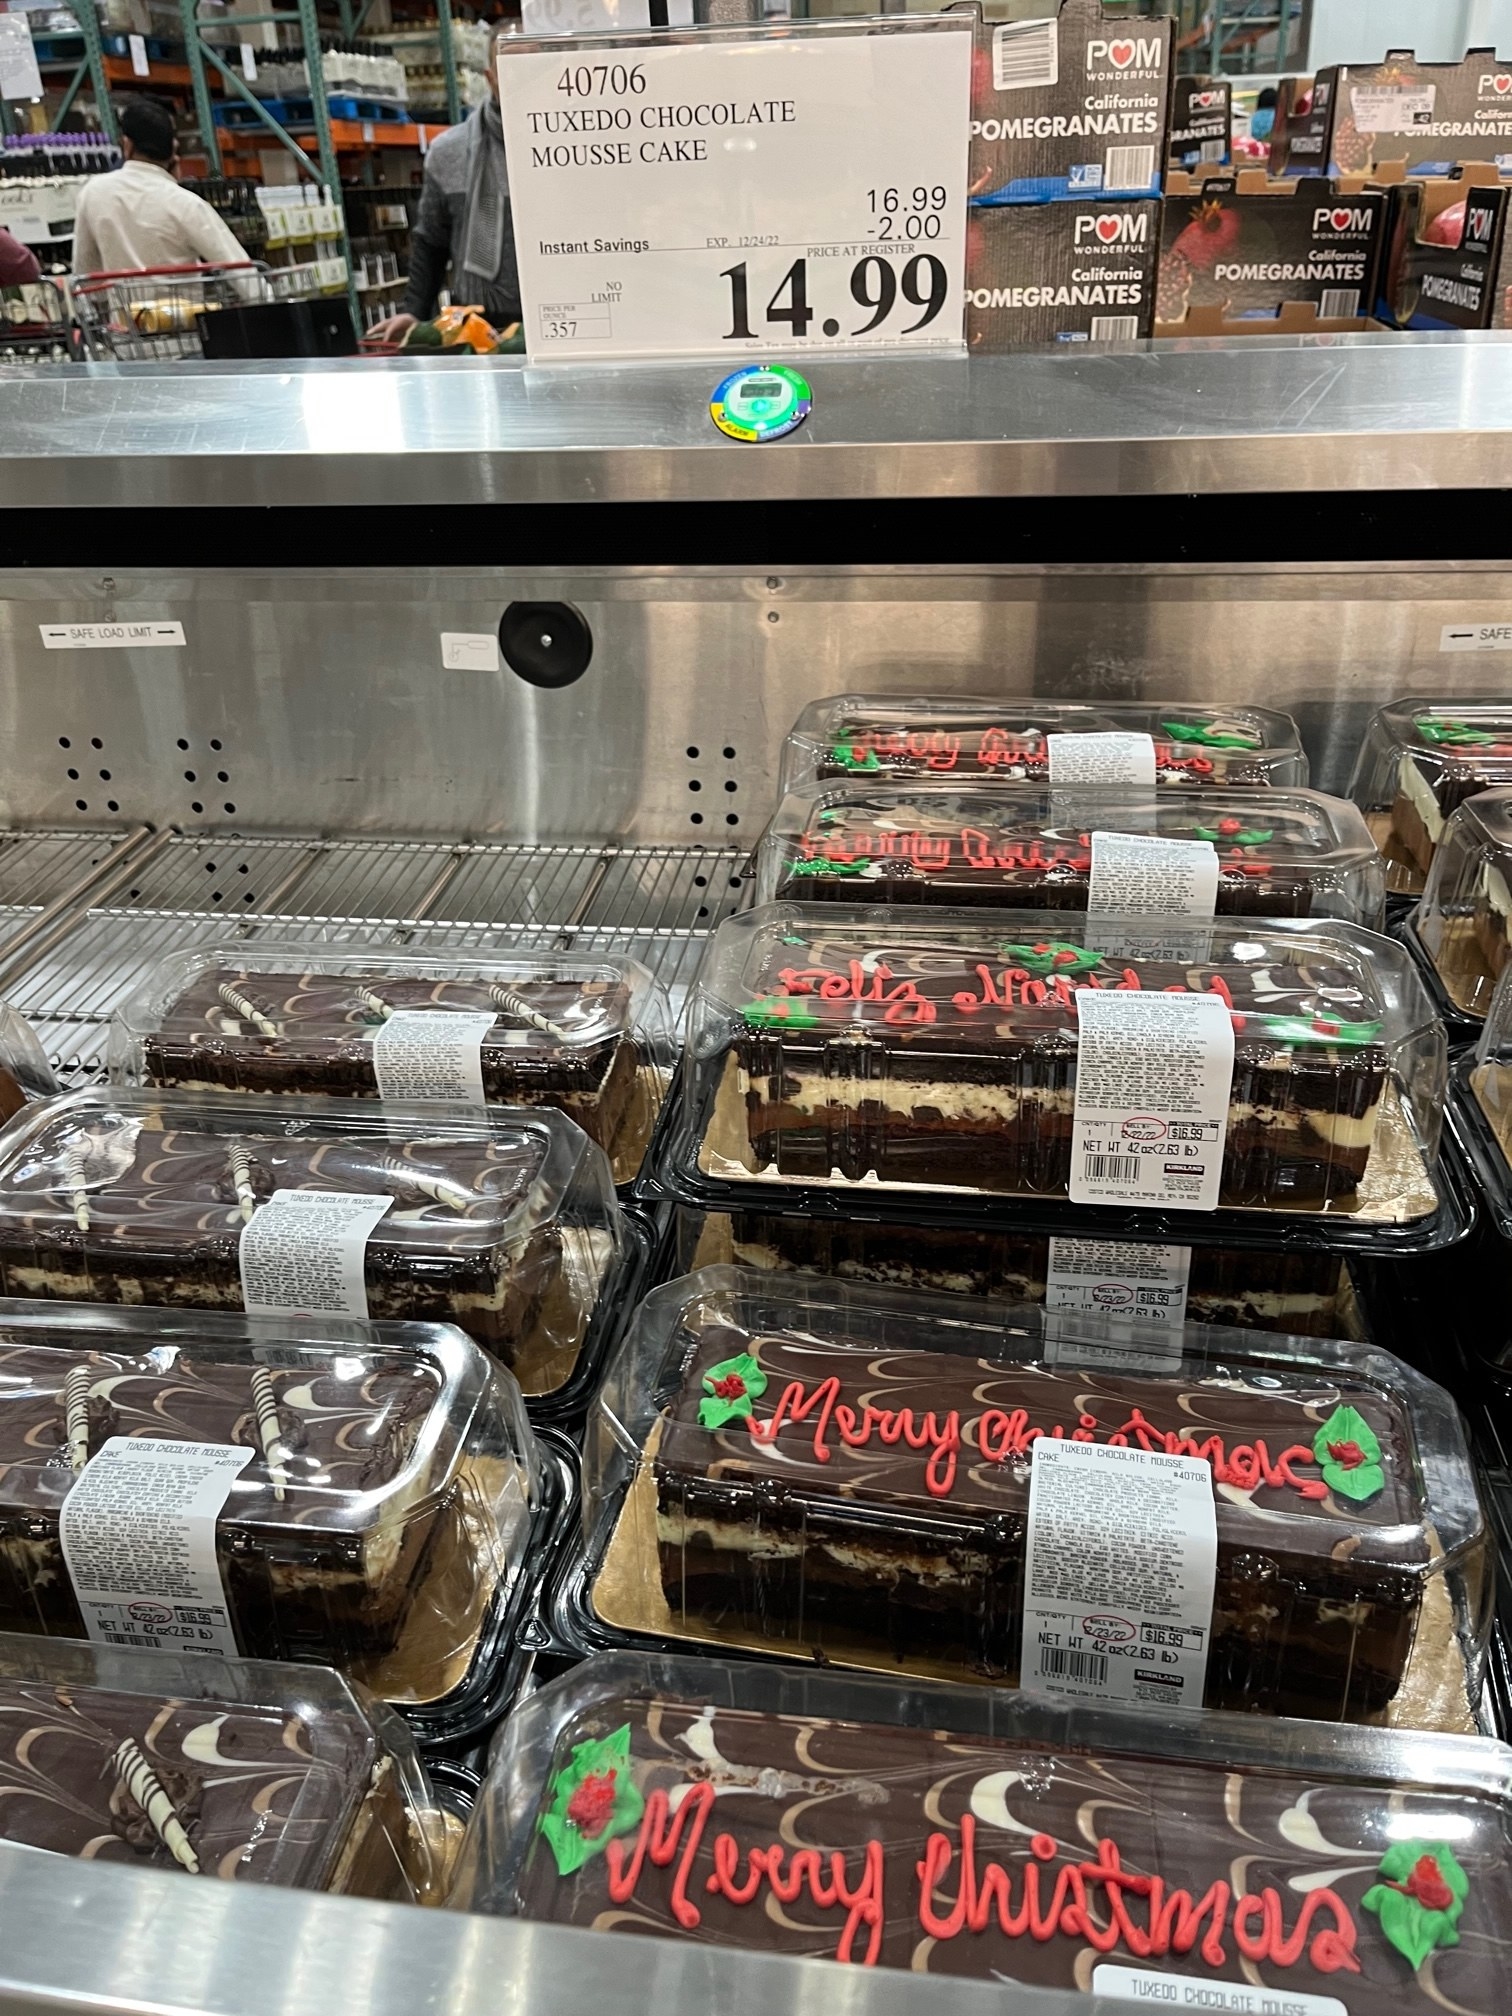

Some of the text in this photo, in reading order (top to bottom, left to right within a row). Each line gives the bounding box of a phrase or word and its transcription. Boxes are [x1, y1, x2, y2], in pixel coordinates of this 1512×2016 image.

[1086, 37, 1162, 70] POM
[557, 63, 647, 97] 40706
[1086, 69, 1160, 82] WONDERFUL
[1477, 73, 1512, 95] PO
[1084, 93, 1159, 111] California
[527, 100, 796, 134] TUXEDO CHOCOLATE
[971, 111, 1158, 141] POMEGRANATES
[531, 139, 708, 167] MOUSSE CAKE
[867, 186, 947, 213] 16.99
[867, 214, 941, 241] -2.00
[1312, 207, 1373, 232] POM
[1073, 213, 1148, 245] POM
[1311, 232, 1369, 241] WONDERFUL
[539, 237, 650, 255] Instant Savings
[738, 235, 779, 248] 12/24/22
[1073, 244, 1145, 256] WONDERFUL
[807, 243, 915, 258] PRICE AT REGISTER
[1308, 249, 1367, 262] California
[1071, 266, 1143, 283] California
[1214, 263, 1365, 281] POMEGRANATES
[605, 281, 623, 291] NO
[591, 292, 622, 304] LIMIT
[719, 253, 948, 339] 14.99
[963, 283, 1142, 309] POMEGRANATES
[544, 321, 578, 338] .357
[69, 626, 152, 639] SAFE LOAD LIMIT
[1479, 627, 1512, 640] SAFE
[1126, 992, 1167, 1001] CHOCOLATE
[1171, 1127, 1203, 1140] $16.99
[1083, 1140, 1102, 1152] NET
[1108, 1141, 1121, 1153] WT
[1127, 1142, 1140, 1154] 42
[1140, 1292, 1169, 1305] $16.99
[745, 1375, 960, 1497] Merry
[100, 1450, 122, 1458] CAKE
[126, 1441, 233, 1459] TUXEDO CHOCOLATE MOUSSE
[1037, 1451, 1060, 1463] CAKE
[1060, 1443, 1184, 1469] TUXEDO CHOCOLATE MOUSSE
[1173, 1470, 1207, 1483] #40706
[97, 1619, 117, 1631] NET
[122, 1621, 136, 1633] WT
[180, 1611, 212, 1625] $16.99
[1037, 1631, 1060, 1647] NET
[1068, 1636, 1084, 1649] WT
[1092, 1640, 1107, 1654] 42
[1161, 1649, 1180, 1664] lb)
[1145, 1630, 1184, 1648] $16.99
[1136, 1670, 1183, 1683] KIRKLAND
[606, 1780, 1362, 1976] Merry Christmas
[1131, 1979, 1308, 2016] TUXEDO CHOCOLATE MOUSSE
